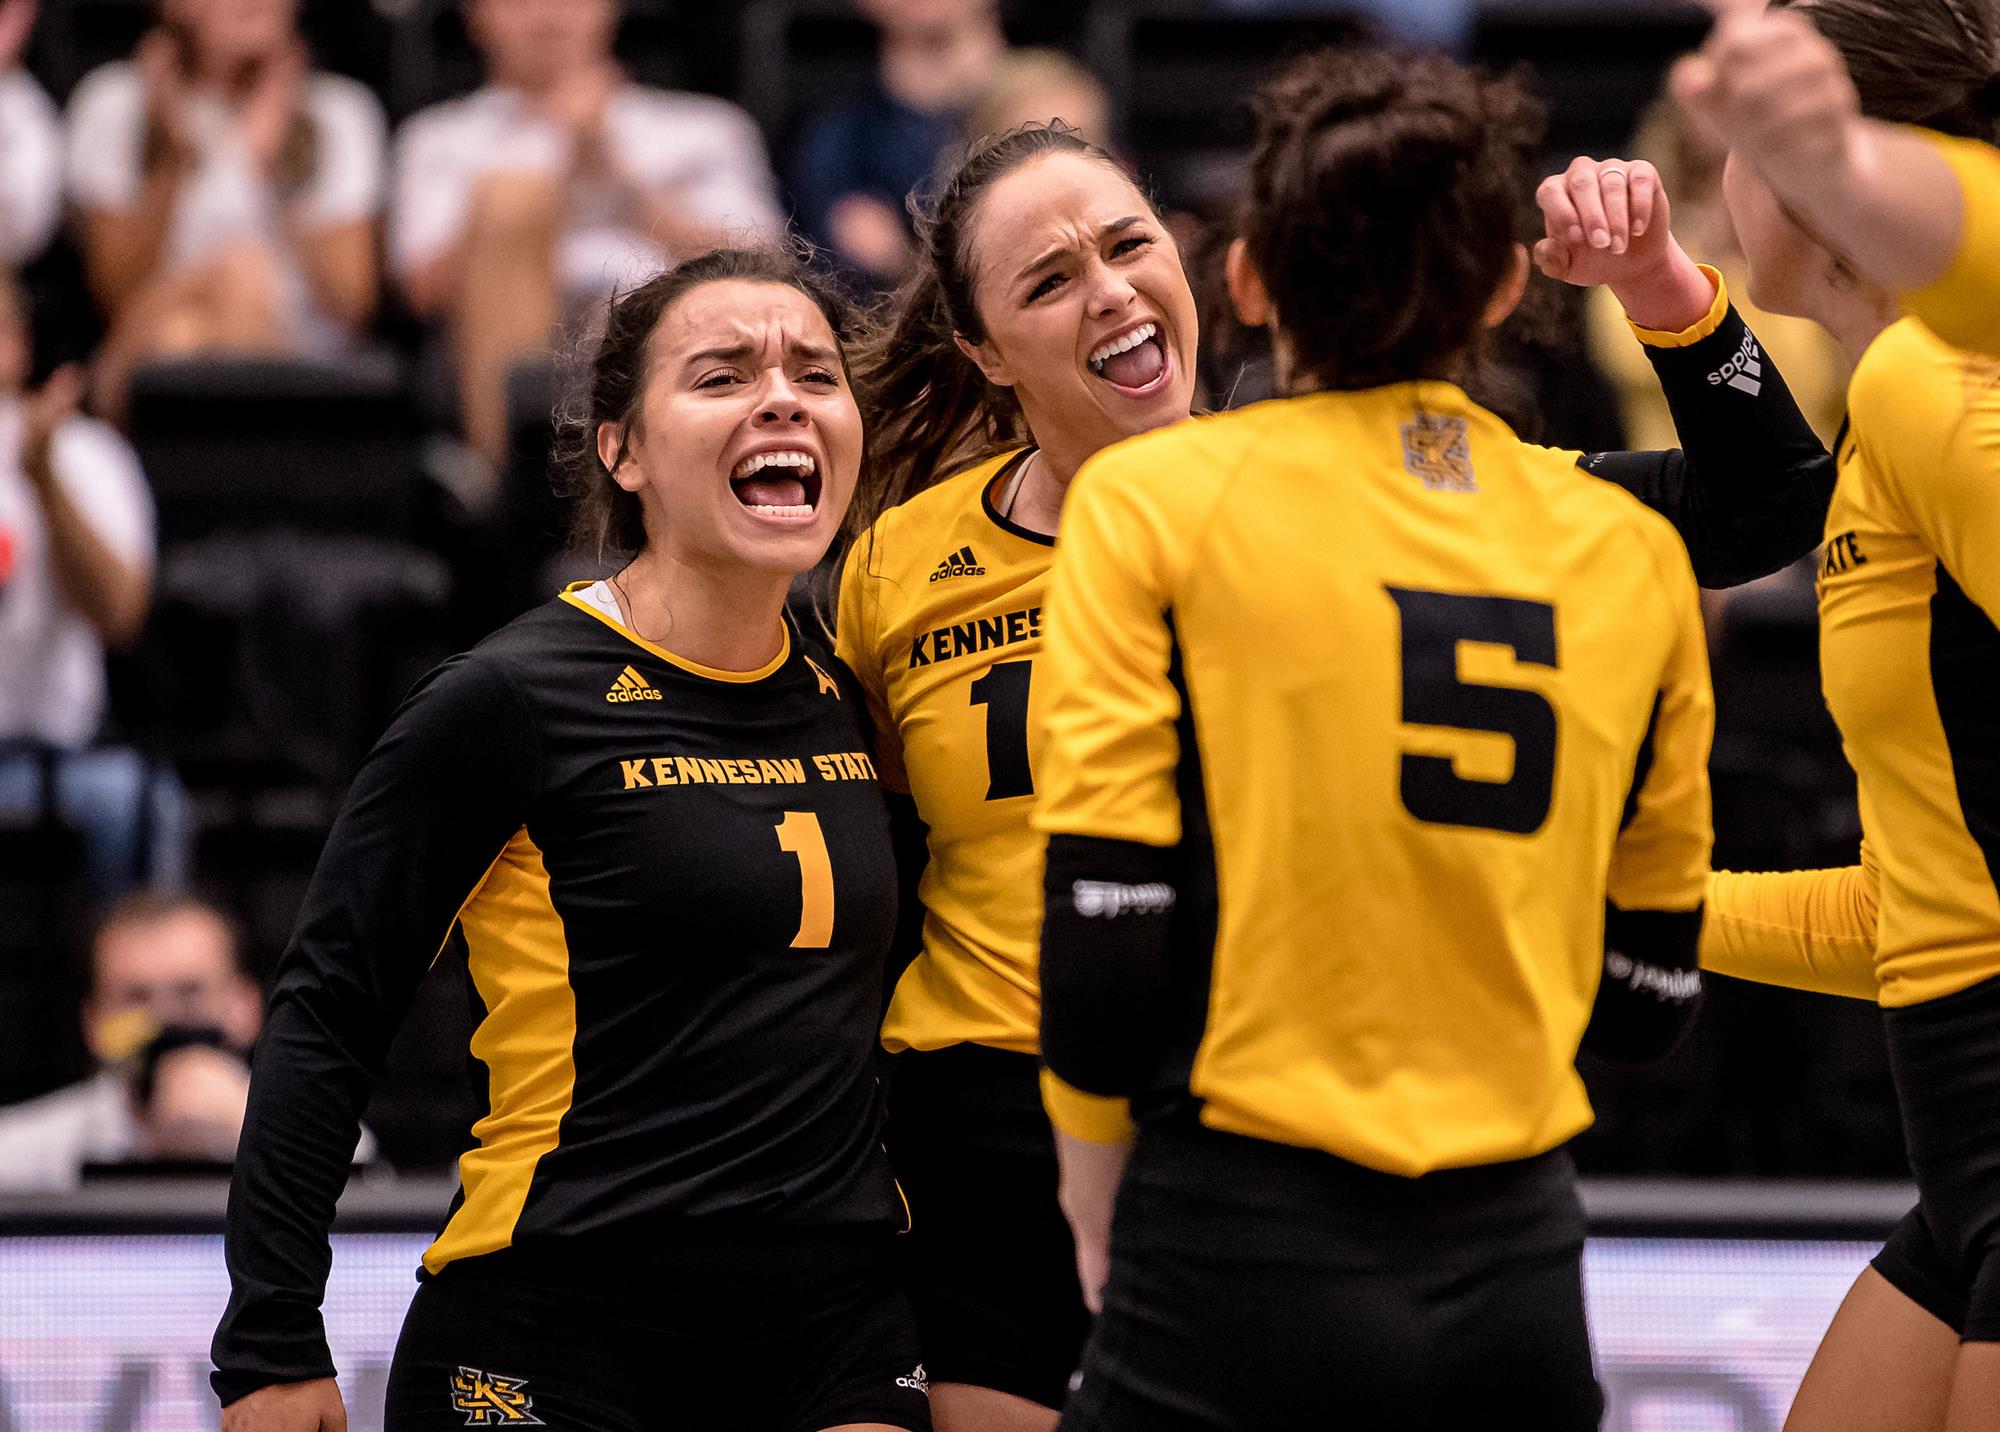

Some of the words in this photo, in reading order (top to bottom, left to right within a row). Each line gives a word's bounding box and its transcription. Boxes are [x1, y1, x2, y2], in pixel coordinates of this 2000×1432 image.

[929, 563, 986, 583] adidas
[606, 686, 663, 703] adidas
[969, 659, 1034, 801] 1
[1382, 584, 1559, 836] 5
[619, 756, 807, 790] KENNESAW
[774, 811, 835, 949] 1
